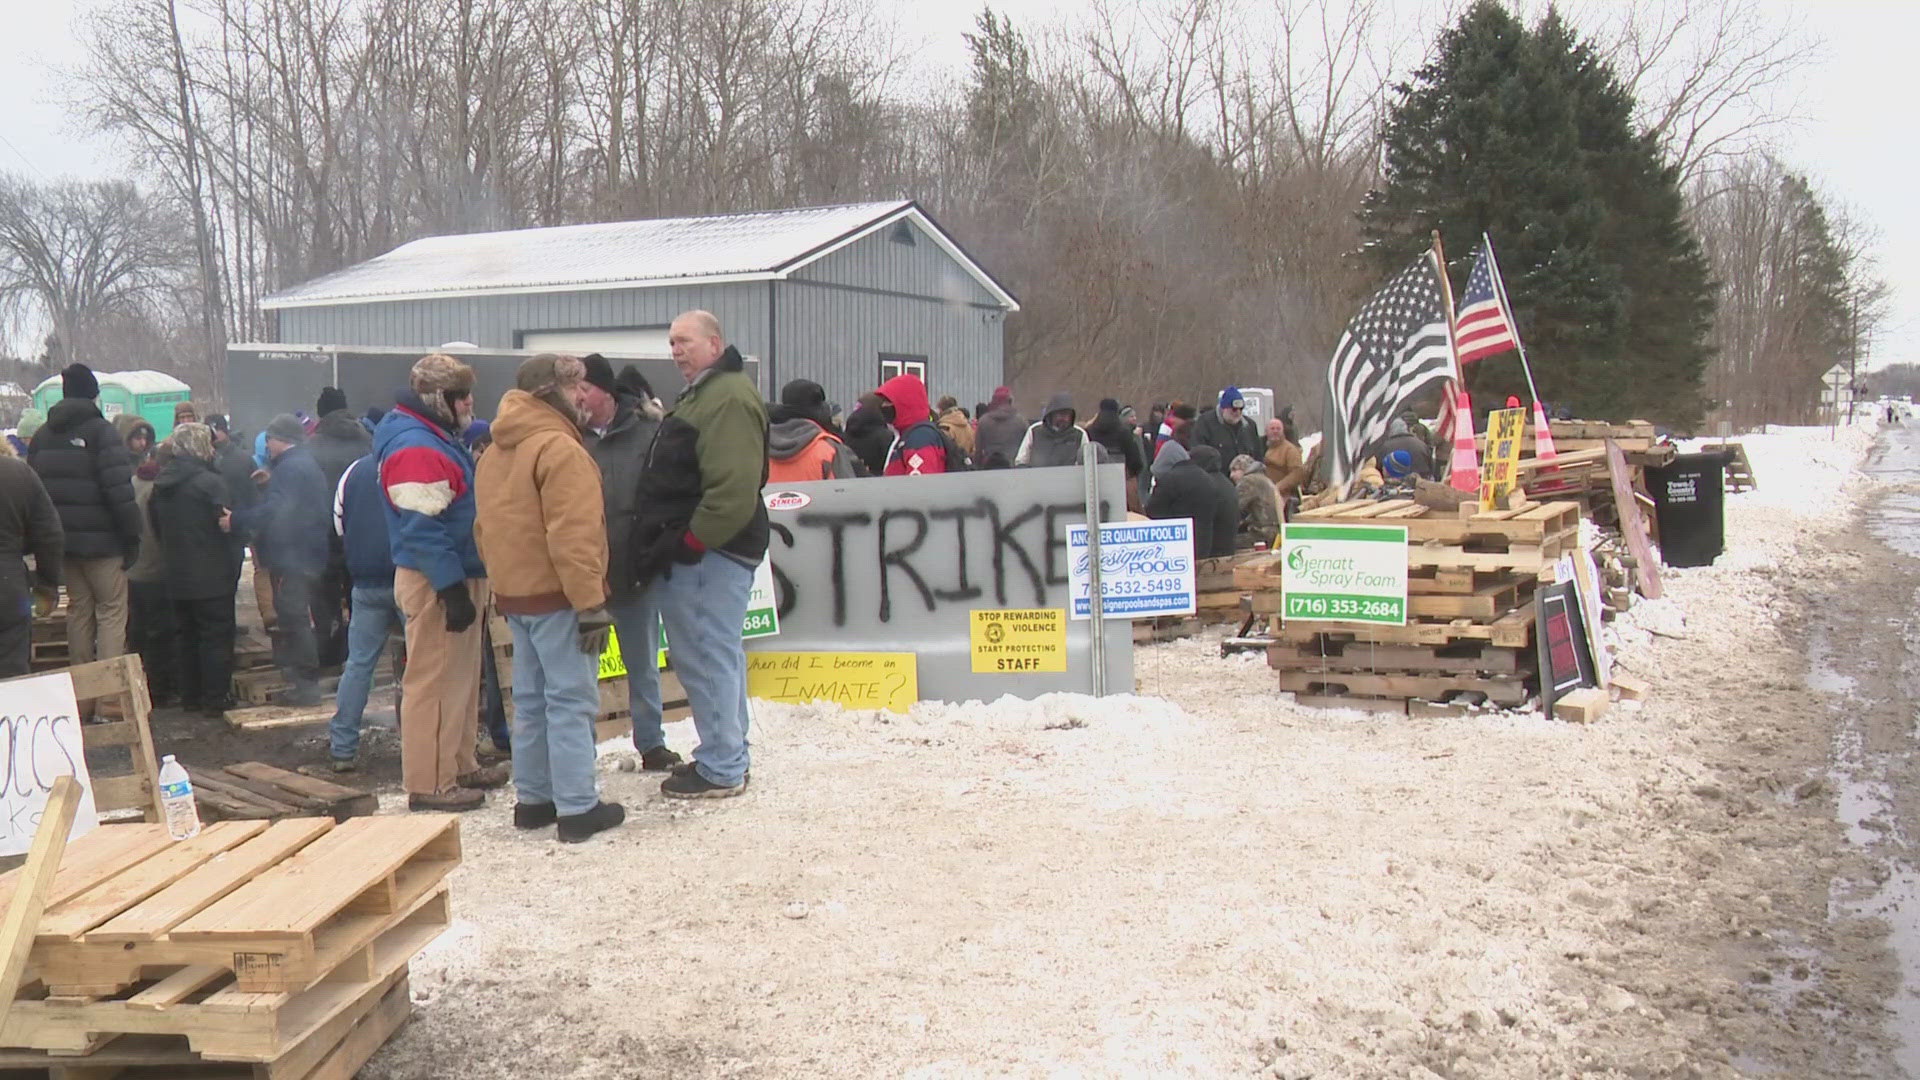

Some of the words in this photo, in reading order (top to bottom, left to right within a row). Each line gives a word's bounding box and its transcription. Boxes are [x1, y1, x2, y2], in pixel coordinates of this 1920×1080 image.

[769, 498, 803, 508] SENECA
[1072, 531, 1113, 545] ANER
[1114, 528, 1150, 542] QUALITY
[1150, 527, 1174, 540] POOL
[1174, 526, 1187, 539] BY
[1128, 559, 1186, 574] POOLS
[1310, 570, 1353, 588] Spray
[1355, 571, 1396, 588] Foam
[1081, 578, 1182, 595] 76-532-5498
[1290, 598, 1327, 615] (716)
[1330, 599, 1400, 617] 353-2684
[978, 612, 1001, 621] STOP
[1004, 611, 1056, 620] REWARDING
[1012, 624, 1056, 632] VIOLENCE
[978, 645, 1003, 653] START
[1005, 644, 1056, 652] PROTECTING
[781, 656, 800, 670] did
[808, 656, 823, 669] I
[833, 656, 873, 669] become
[997, 658, 1040, 670] STAFF
